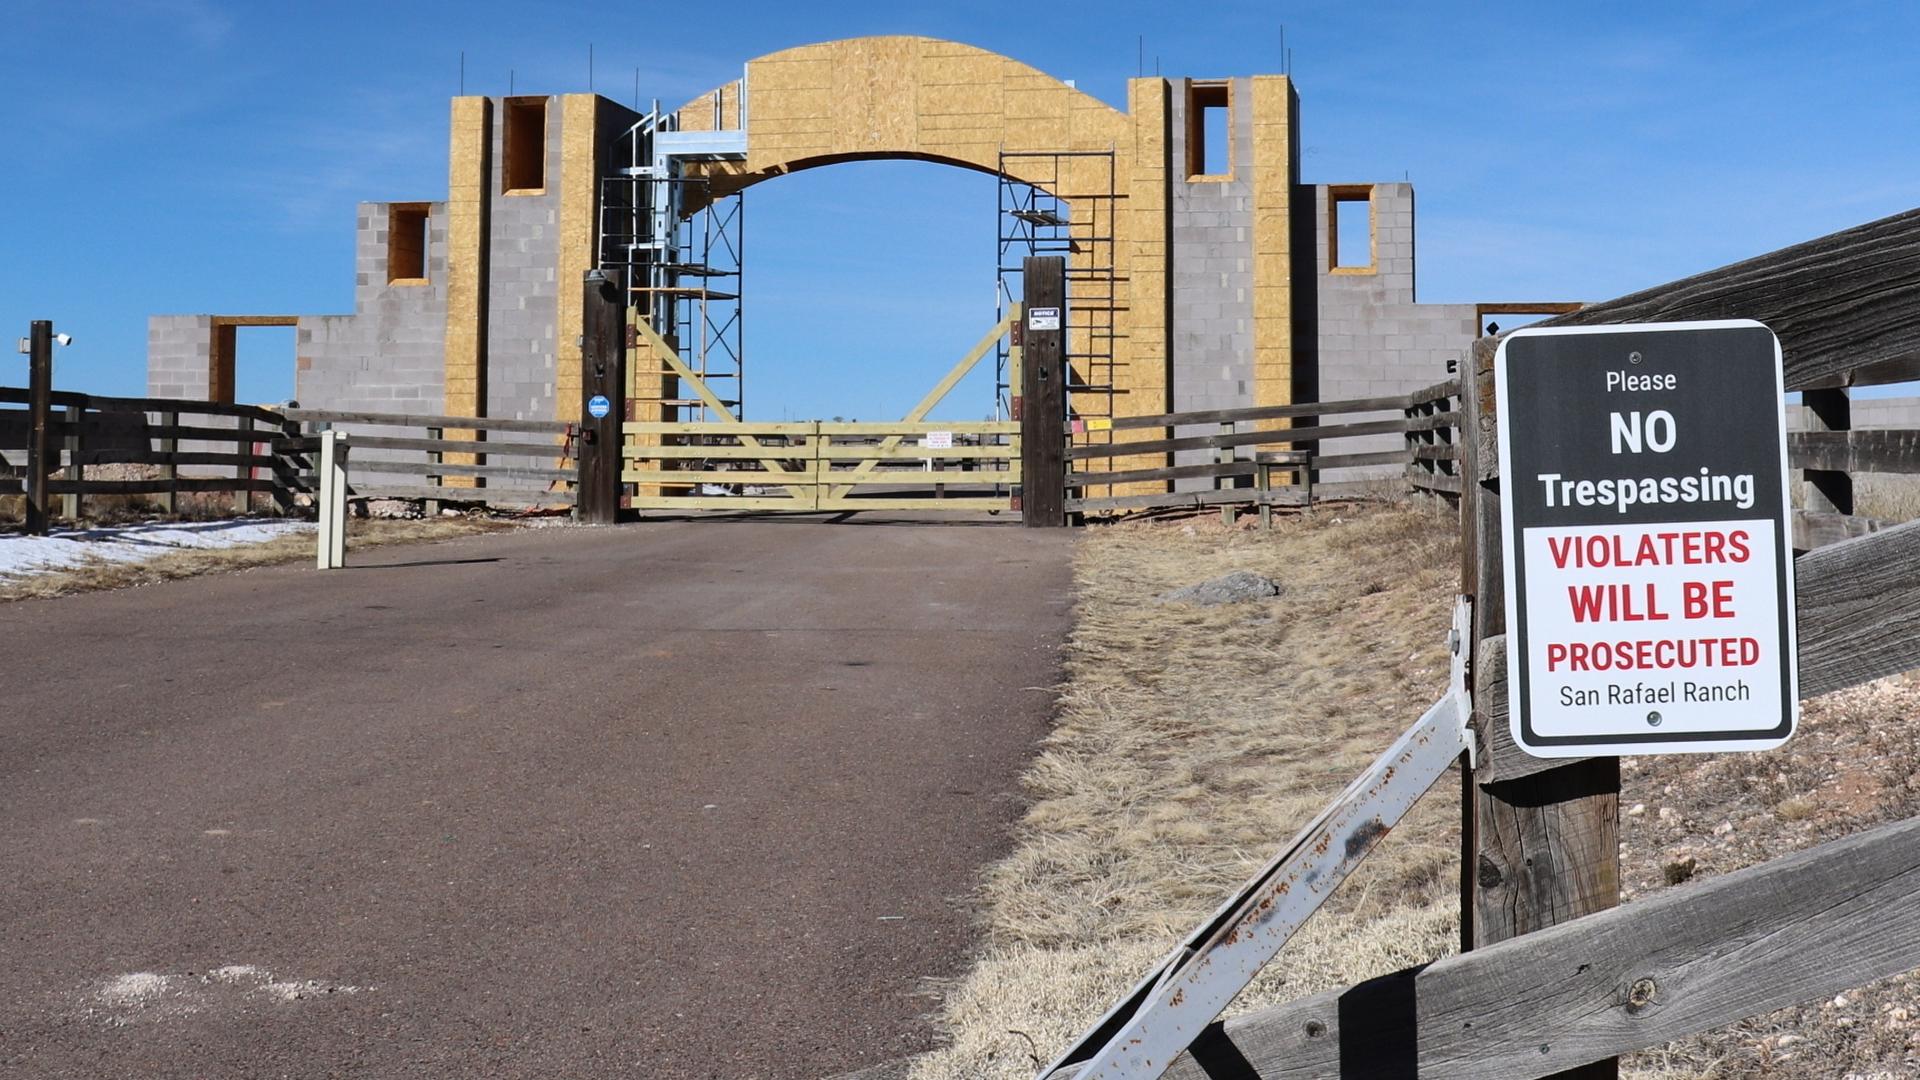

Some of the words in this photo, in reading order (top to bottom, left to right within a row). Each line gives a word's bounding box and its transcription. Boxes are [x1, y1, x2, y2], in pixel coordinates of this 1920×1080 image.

[1606, 370, 1677, 392] Please
[1610, 409, 1677, 455] NO
[1537, 466, 1755, 514] Trespassing
[1547, 530, 1750, 569] VIOLATERS
[1567, 583, 1669, 623] WILL
[1683, 580, 1736, 620] BE
[1547, 637, 1760, 672] PROSECUTED
[1560, 685, 1600, 707] San
[1608, 682, 1676, 705] Rafael
[1684, 679, 1750, 702] Ranch
